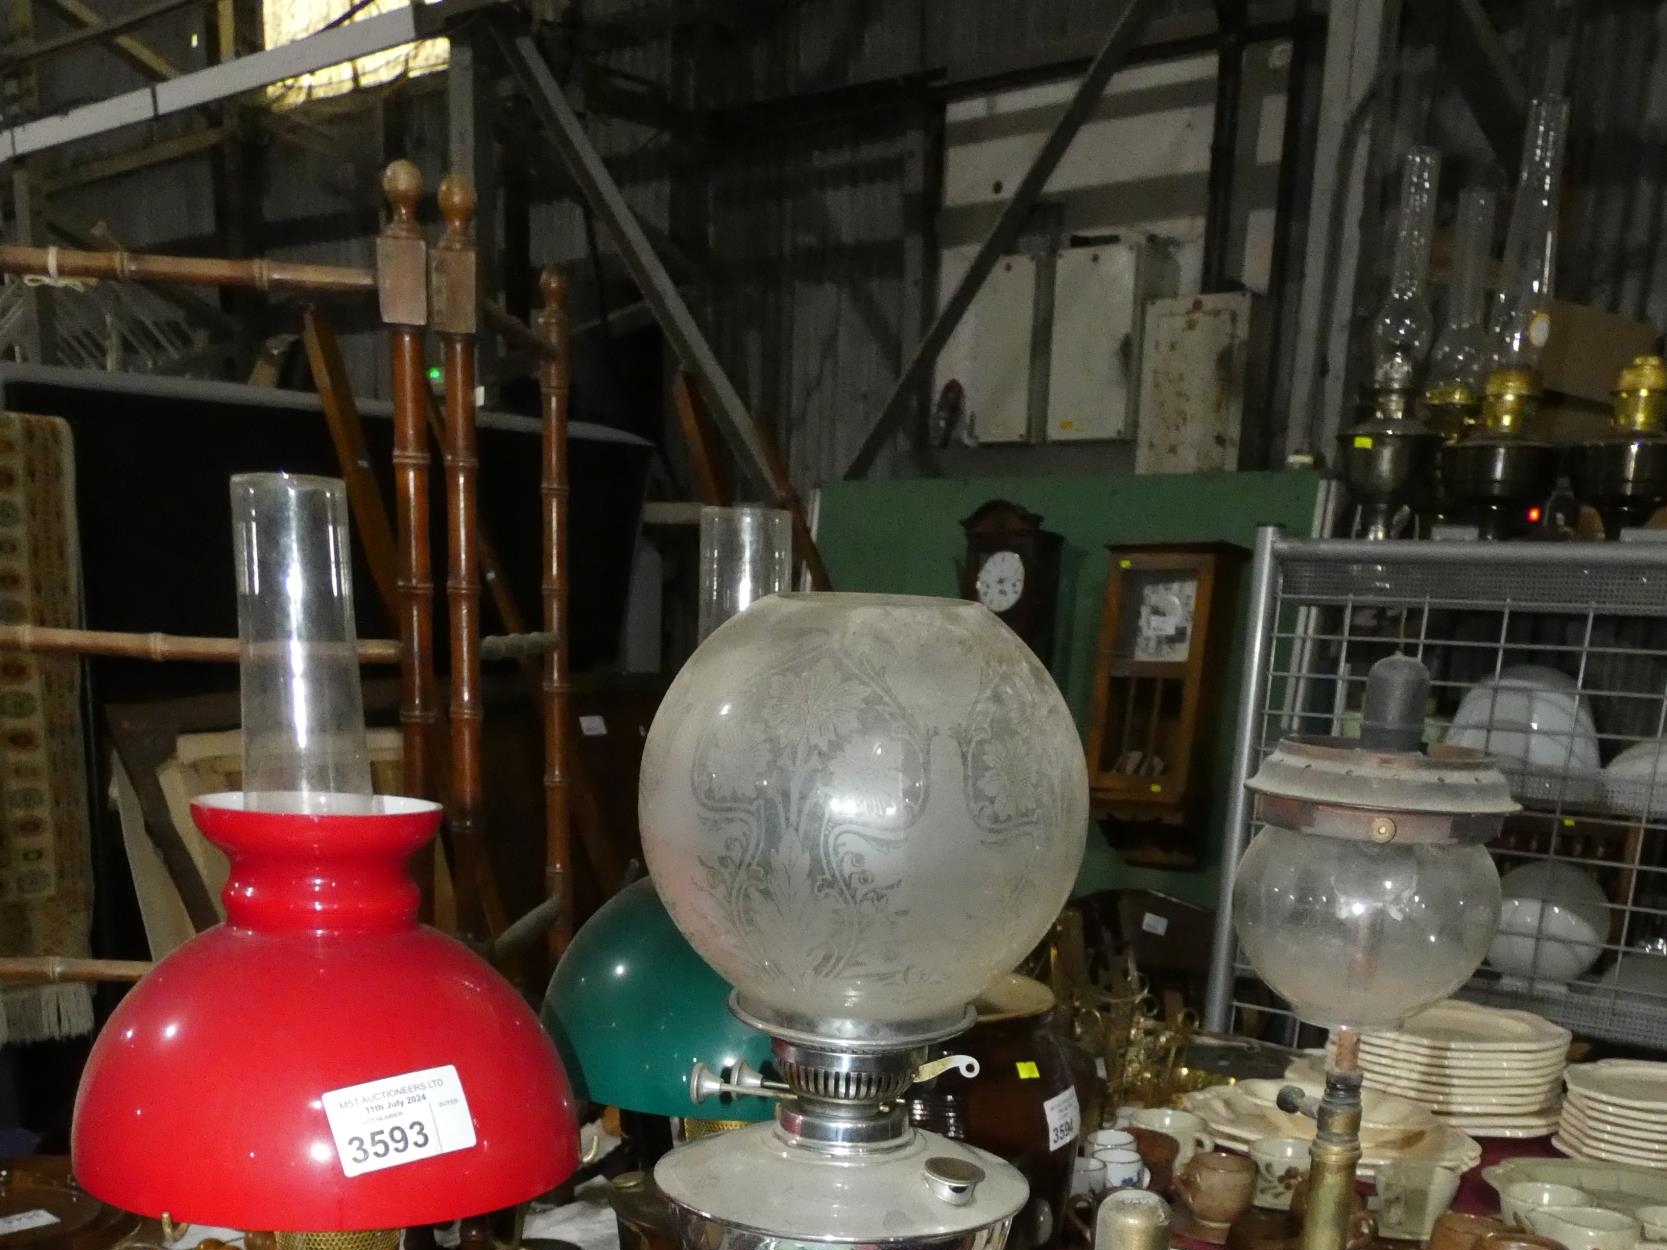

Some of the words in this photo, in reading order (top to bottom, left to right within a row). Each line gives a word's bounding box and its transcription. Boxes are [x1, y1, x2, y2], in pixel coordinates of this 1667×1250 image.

[338, 1097, 359, 1109] MST
[361, 1082, 427, 1104] AUCTIONEERS
[427, 1078, 444, 1089] LTD
[365, 1103, 384, 1114] 11th
[387, 1099, 404, 1109] July
[406, 1093, 427, 1105] 2024
[347, 1120, 430, 1164] 3593
[1053, 1118, 1074, 1144] 3594
